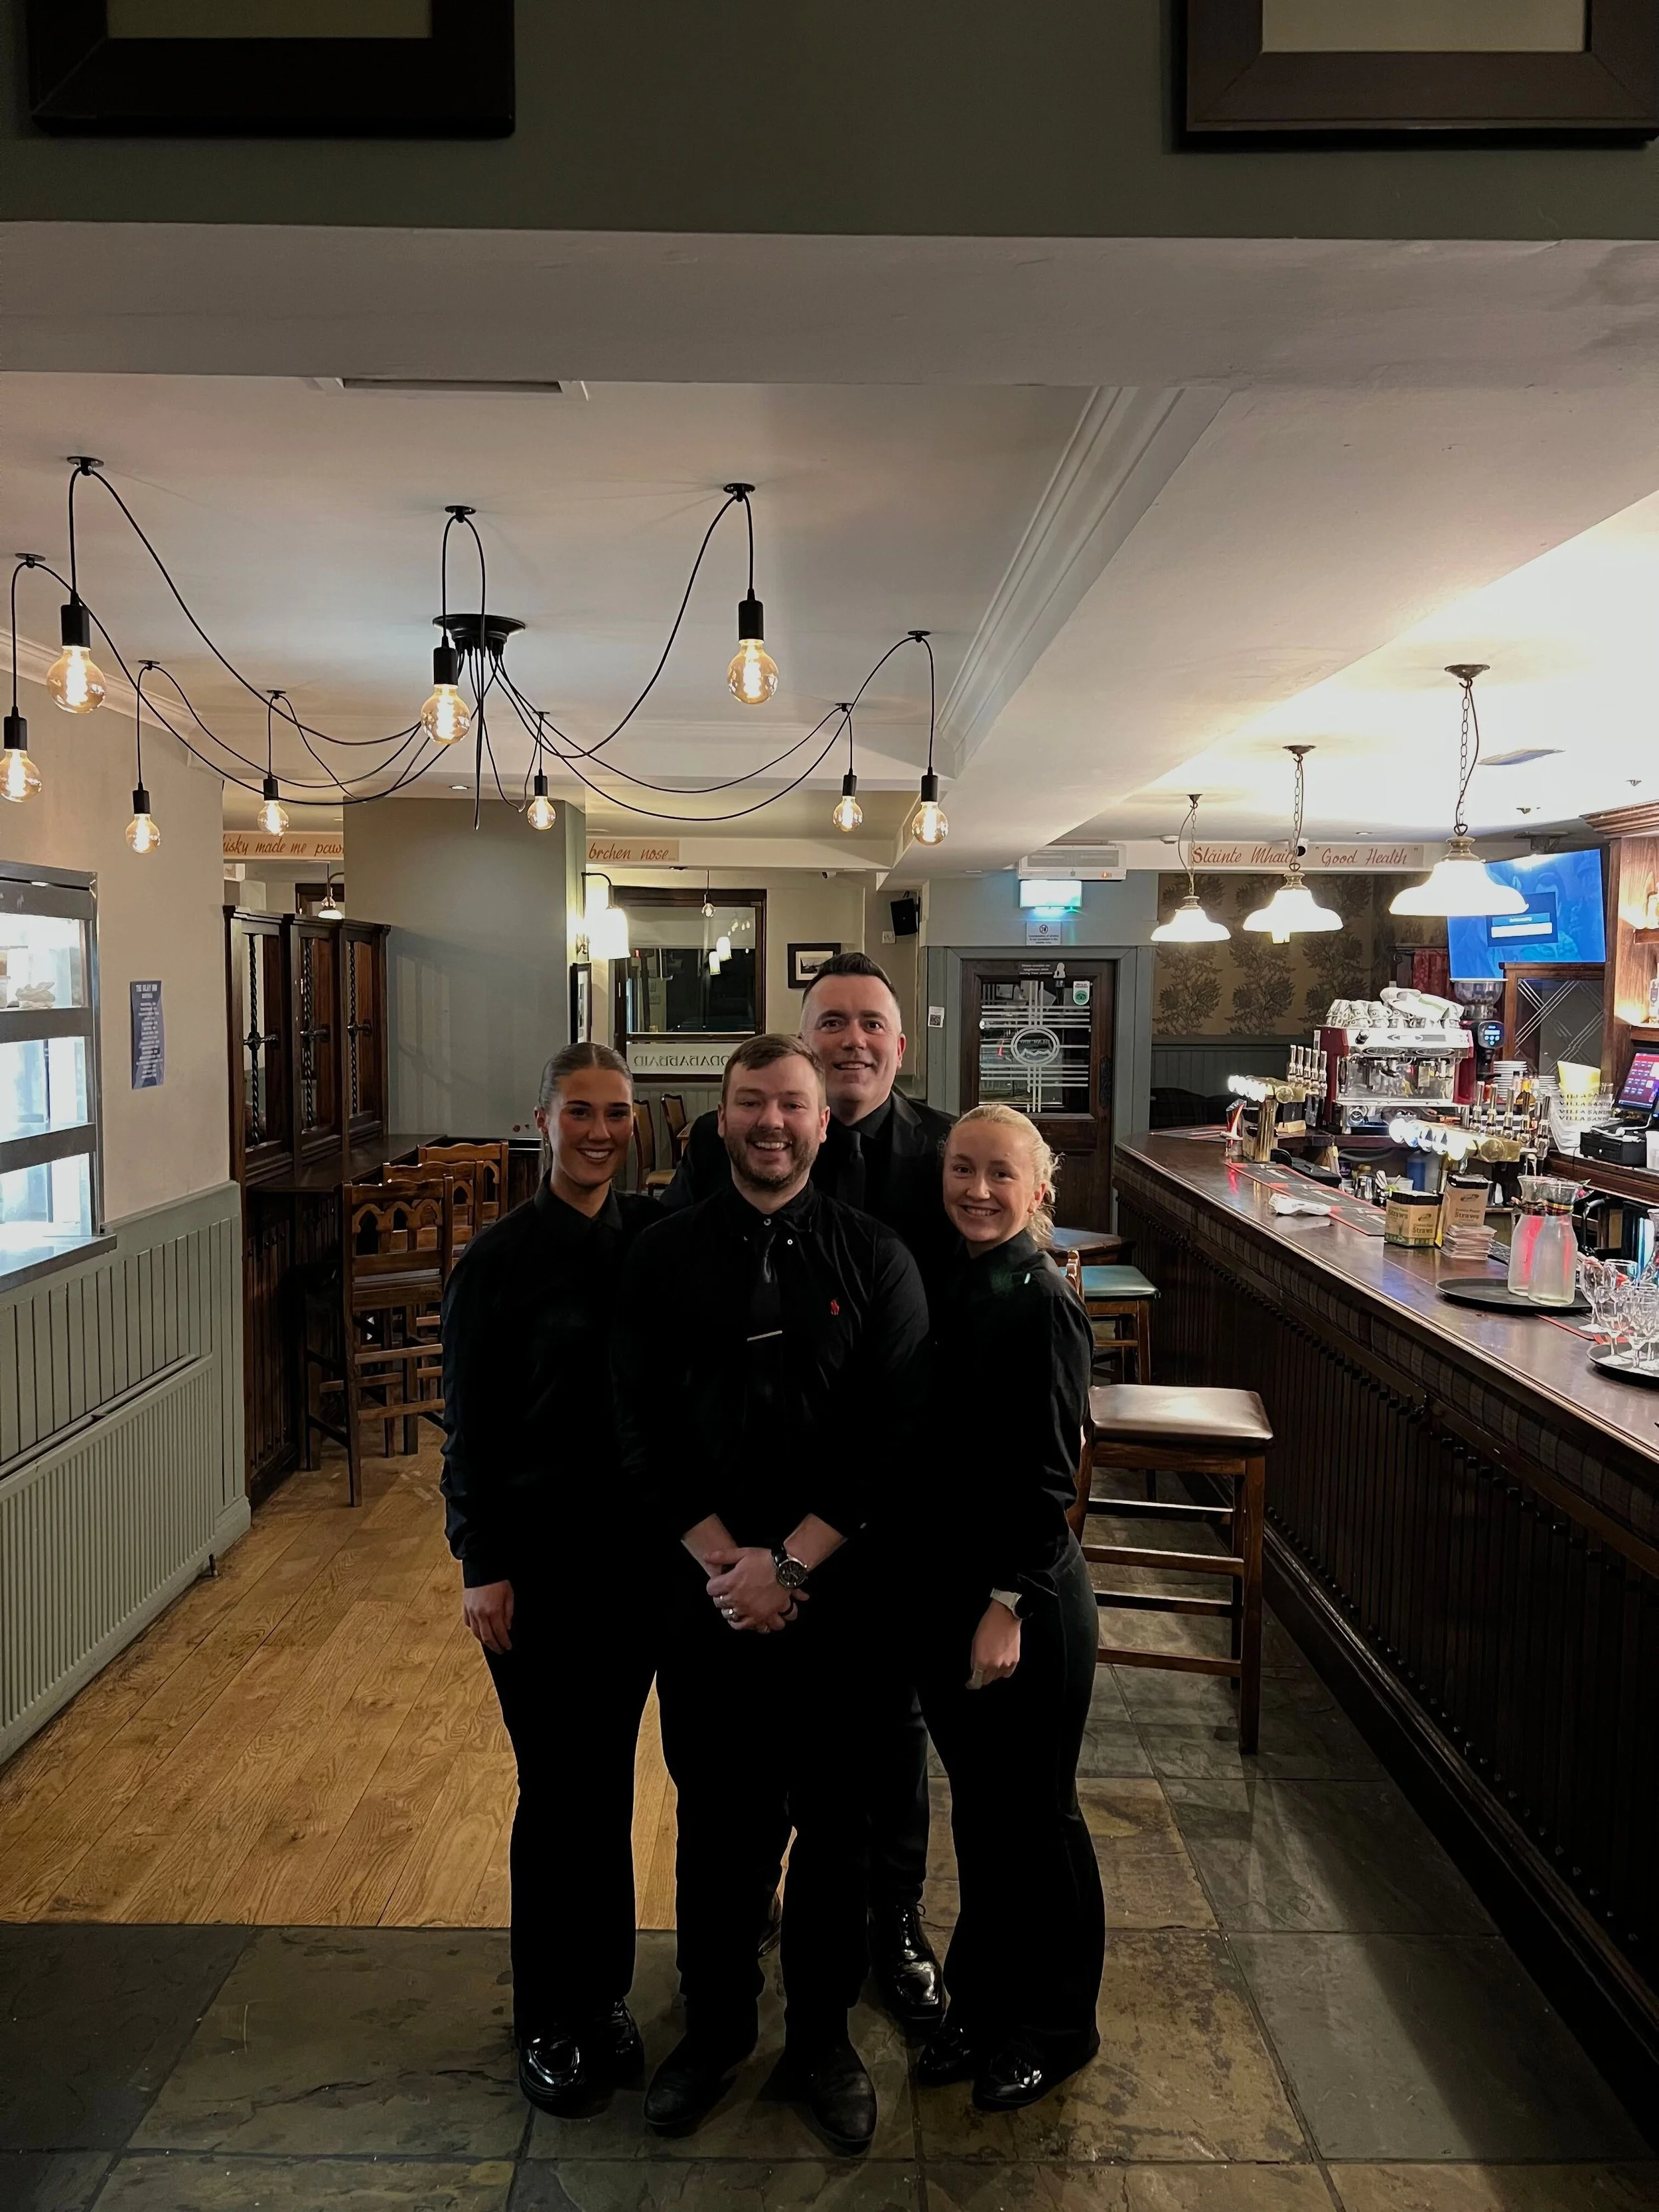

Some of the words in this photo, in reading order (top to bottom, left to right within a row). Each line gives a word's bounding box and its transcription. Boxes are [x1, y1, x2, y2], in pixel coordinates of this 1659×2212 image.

[255, 837, 286, 853] made
[290, 842, 307, 855] me
[314, 842, 344, 857] paw
[1192, 846, 1242, 863] Sláinte
[1388, 1209, 1408, 1219] Straws
